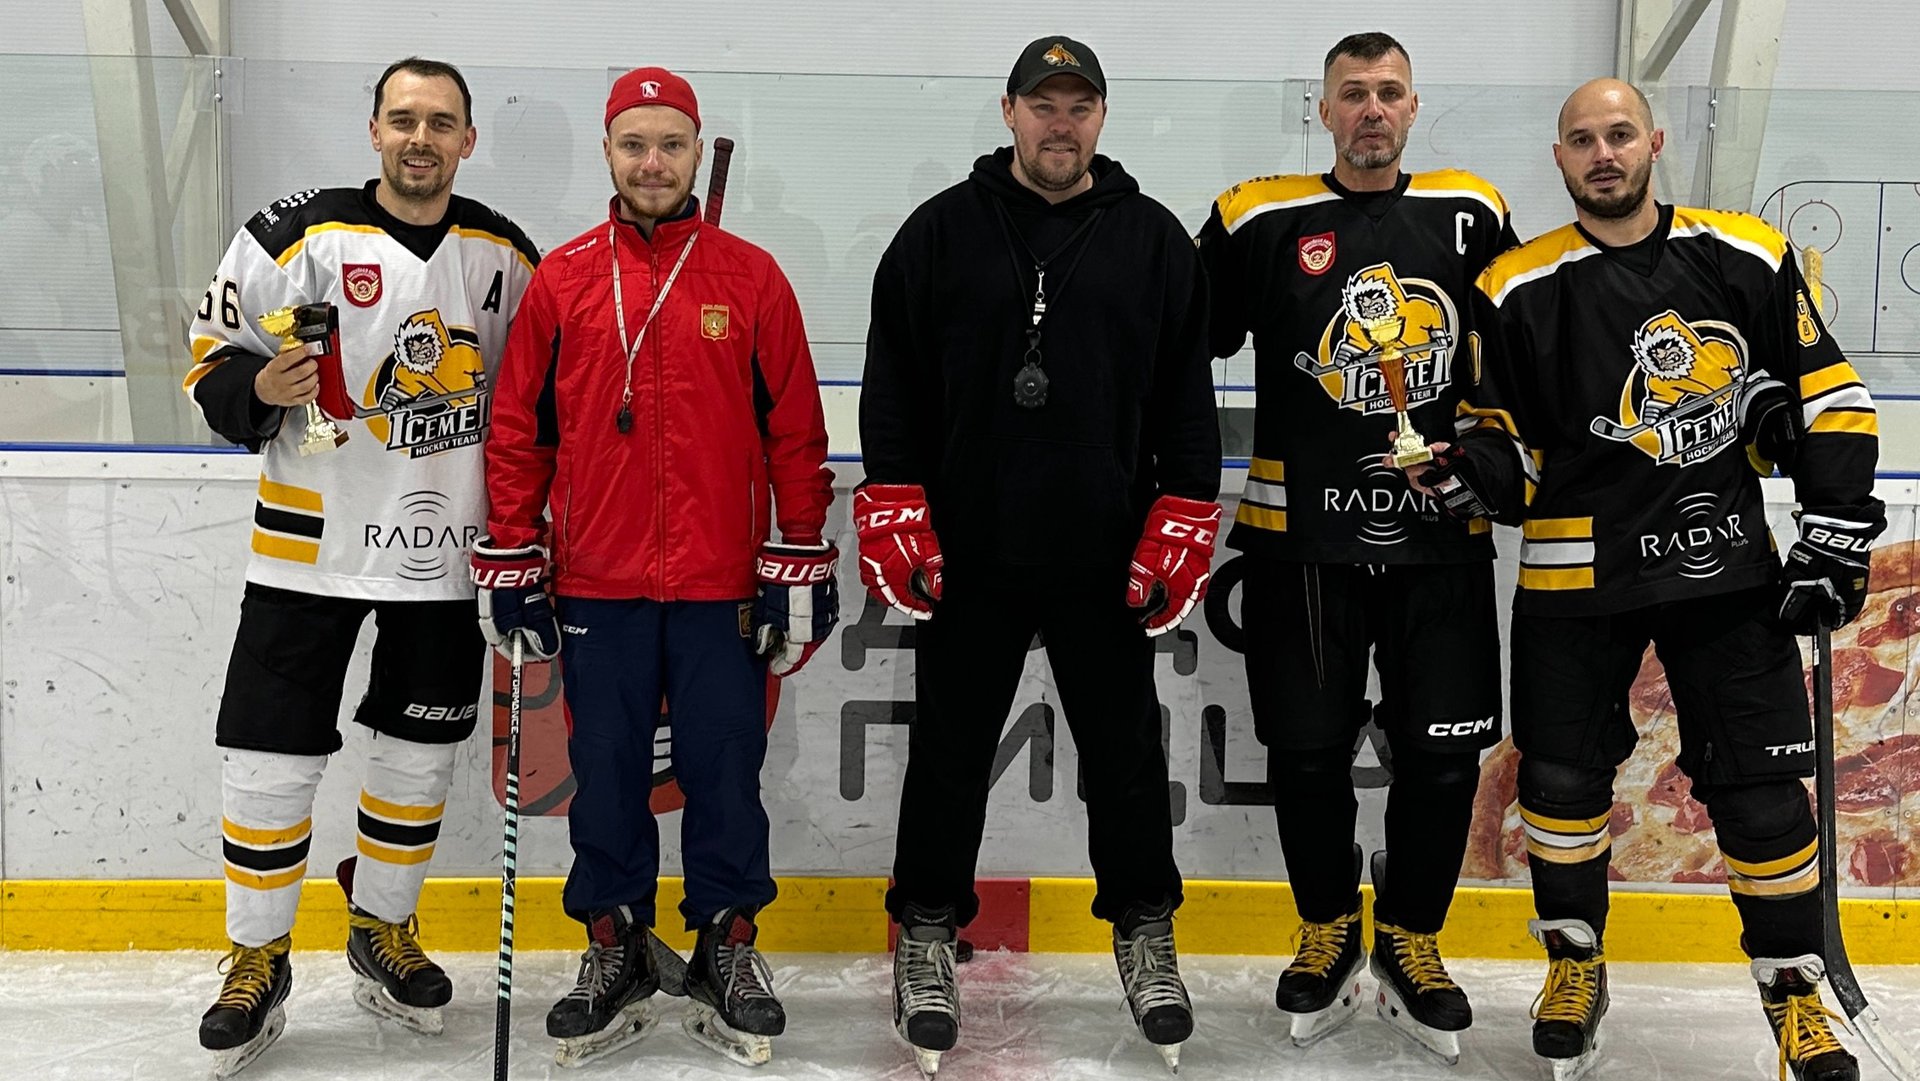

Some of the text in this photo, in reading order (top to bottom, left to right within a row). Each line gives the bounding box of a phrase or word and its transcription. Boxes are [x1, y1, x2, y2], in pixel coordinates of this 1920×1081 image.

[1455, 211, 1474, 255] C
[481, 270, 504, 314] A
[1369, 389, 1432, 411] HOC TEAM
[416, 434, 479, 457] HOCKEY TEAM
[855, 507, 926, 532] CCM
[365, 524, 478, 549] RADAR
[1161, 519, 1214, 546] CC
[1807, 527, 1873, 553] BAU
[468, 564, 542, 588] UER
[511, 665, 521, 734] RFORMANCE
[402, 703, 478, 722] BAUE
[1427, 716, 1494, 737] CCM
[1765, 740, 1815, 757] TRU
